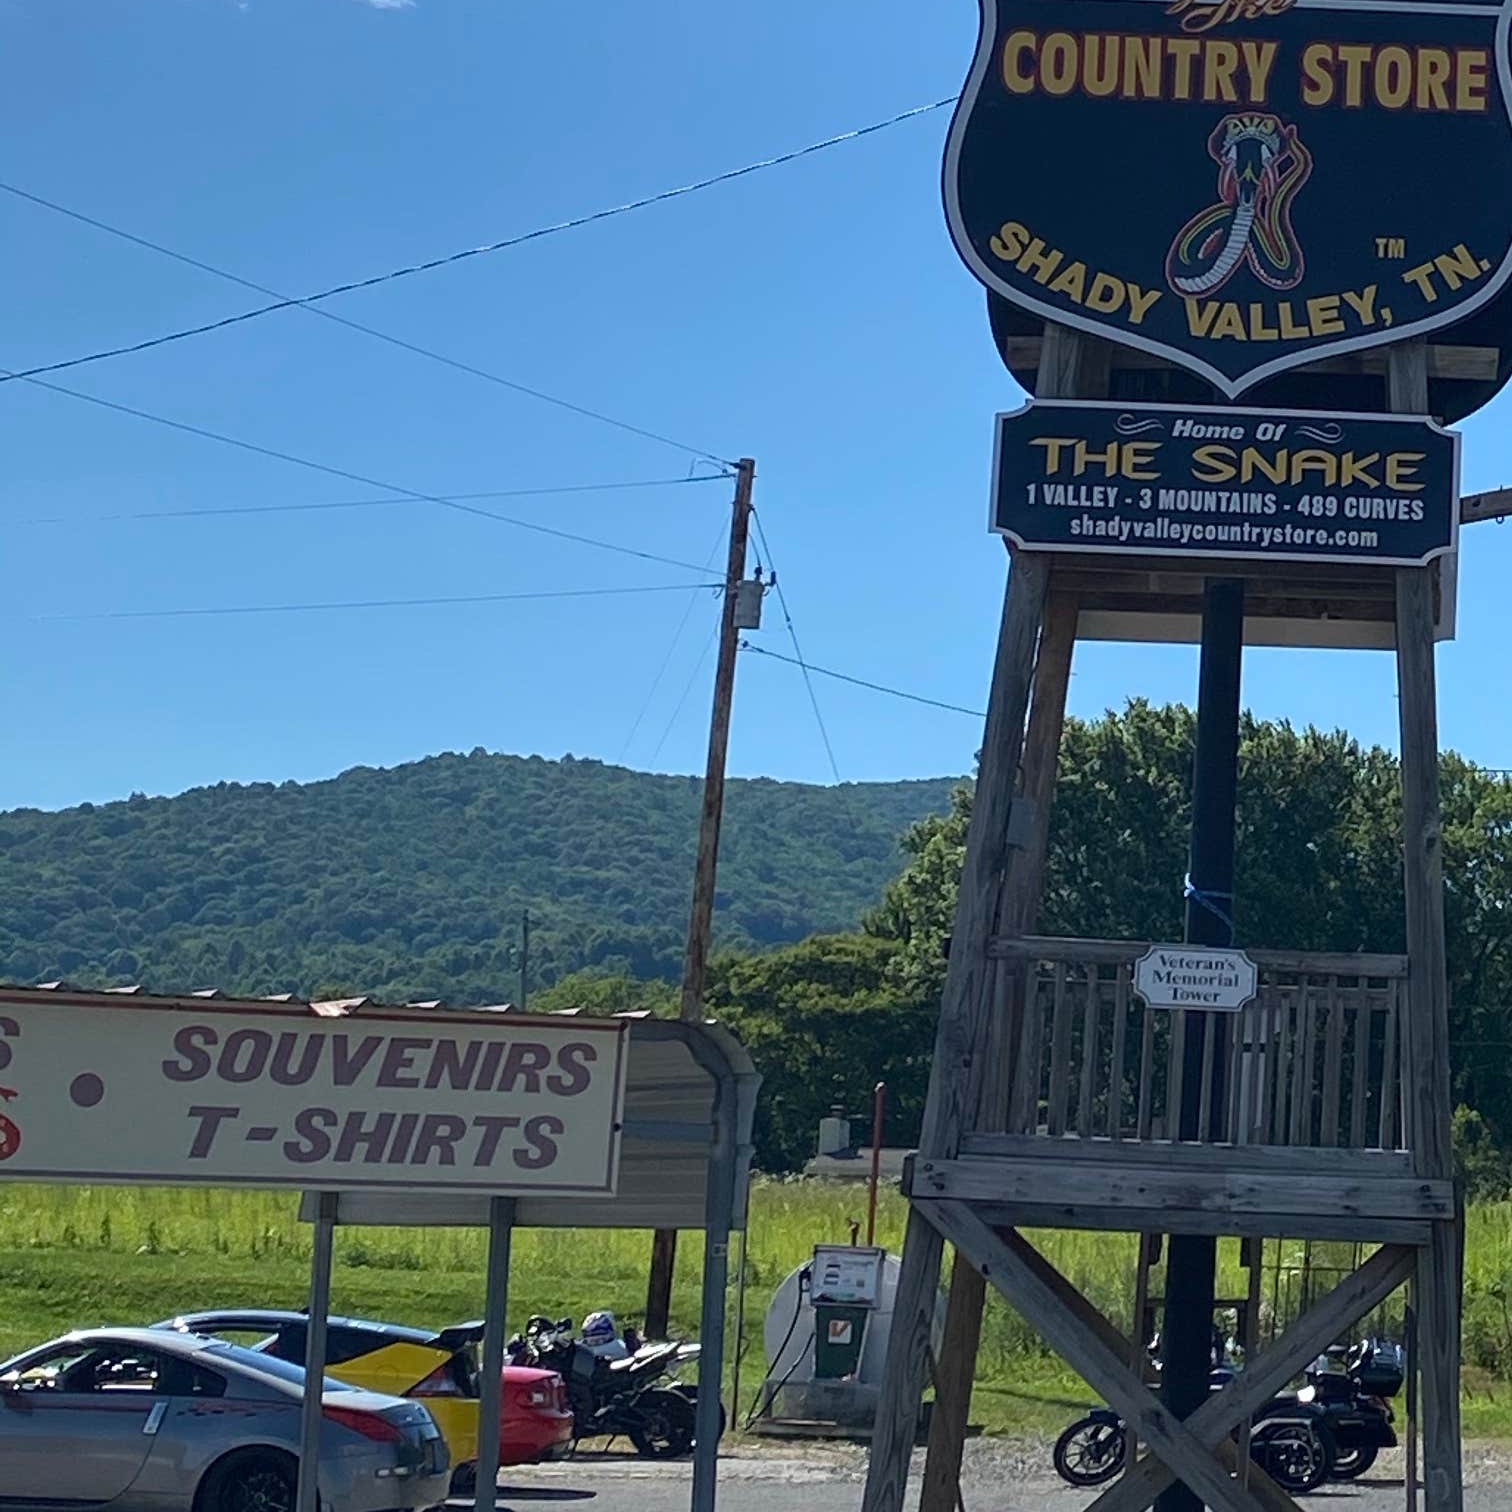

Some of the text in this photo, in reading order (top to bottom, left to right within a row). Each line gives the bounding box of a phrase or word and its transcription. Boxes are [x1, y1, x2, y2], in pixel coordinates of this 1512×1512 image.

[1002, 31, 1489, 112] COUNTRY STORE
[1375, 238, 1405, 259] TM
[989, 221, 1491, 342] SHADY VALLEY, TN.
[1172, 419, 1287, 441] Home Of
[1029, 438, 1426, 491] THE SNAKE
[1027, 483, 1037, 505] 1
[1043, 484, 1118, 508] VALLEY
[1139, 488, 1152, 509] 3
[1158, 489, 1277, 514] MOUNTAINS
[1297, 494, 1338, 517] 489
[1344, 496, 1424, 520] CURVES
[1070, 514, 1378, 548] shadyvalleycountrystore.com
[1152, 970, 1239, 987] Memorial
[1159, 954, 1236, 971] Veteran's
[1168, 987, 1221, 1003] Tower
[162, 1026, 597, 1096] SOUVENIRS
[187, 1106, 564, 1169] T-SHIRTS
